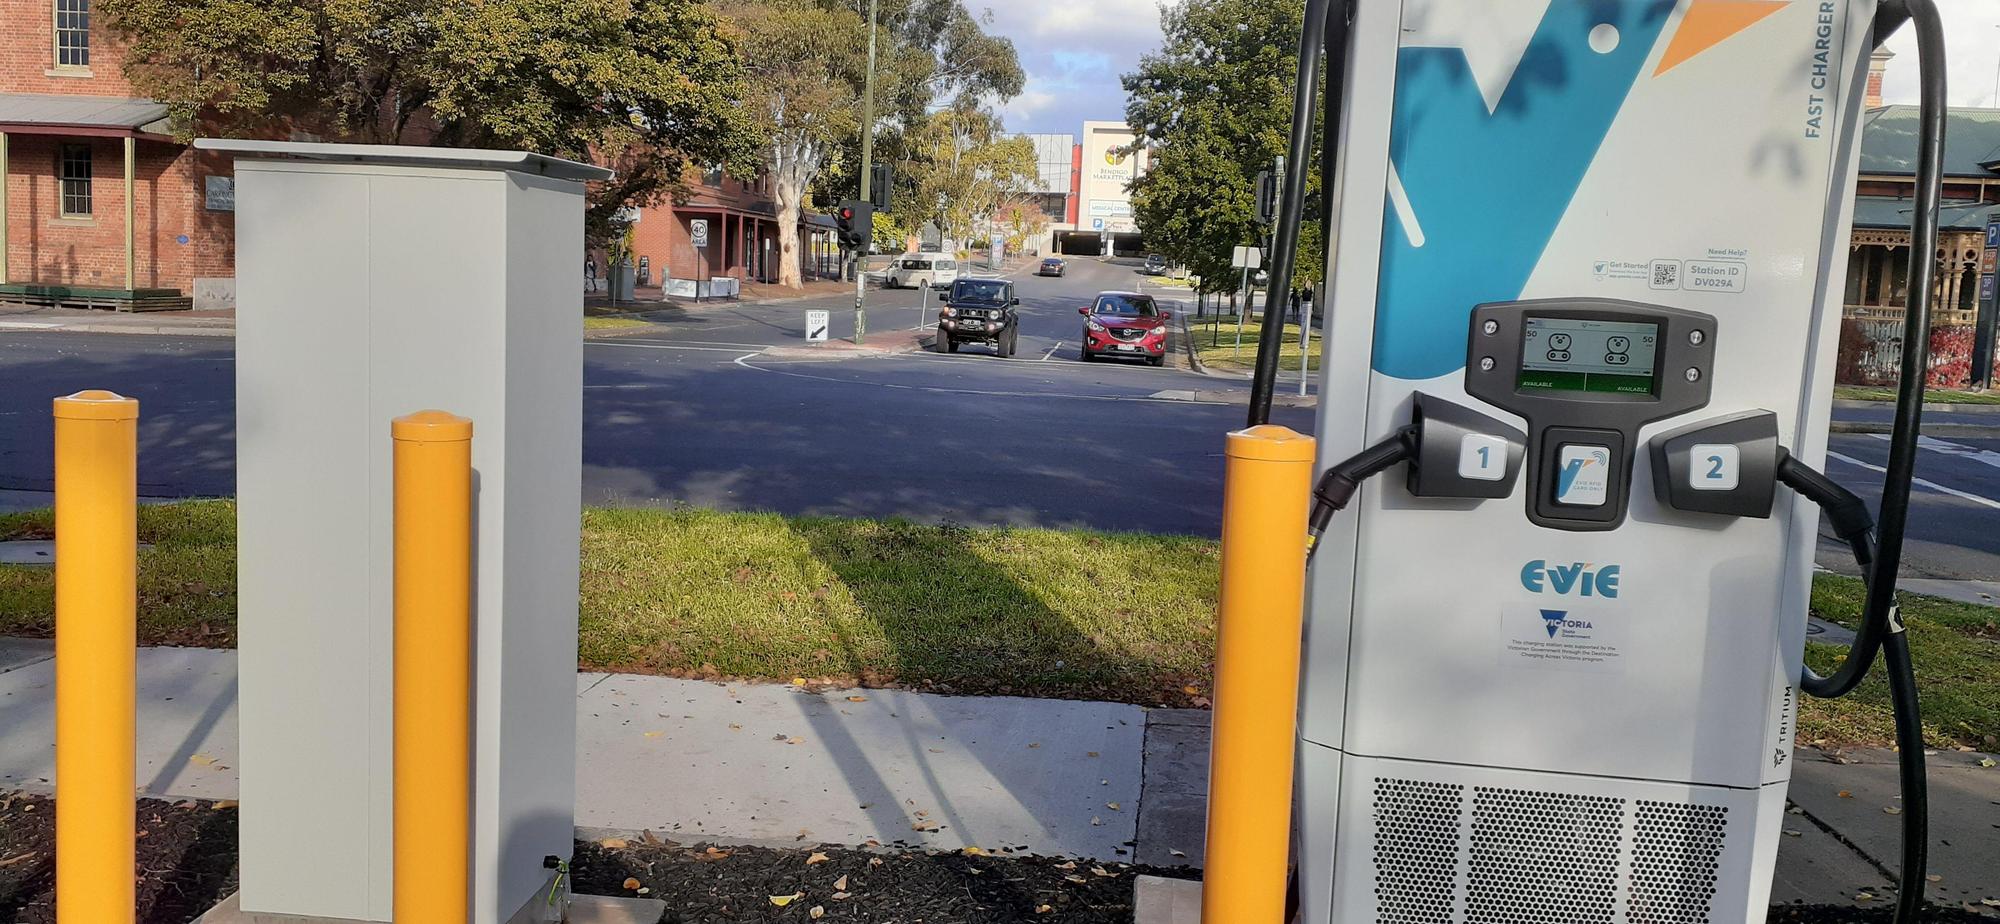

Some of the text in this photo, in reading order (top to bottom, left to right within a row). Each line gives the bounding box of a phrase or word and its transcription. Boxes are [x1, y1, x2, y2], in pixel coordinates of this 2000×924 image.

[1805, 1, 1835, 138] FAST CHARGER
[1093, 173, 1134, 181] MARKETPLAC
[1988, 226, 1997, 243] P
[1728, 249, 1748, 257] Help?
[1610, 261, 1622, 269] Get
[1691, 265, 1739, 276] Station ID
[1695, 278, 1733, 288] DV029A
[1476, 446, 1490, 469] 1
[1706, 455, 1723, 479] 2
[1545, 619, 1593, 629] VICTORIA
[1779, 686, 1792, 744] TRITIUM
